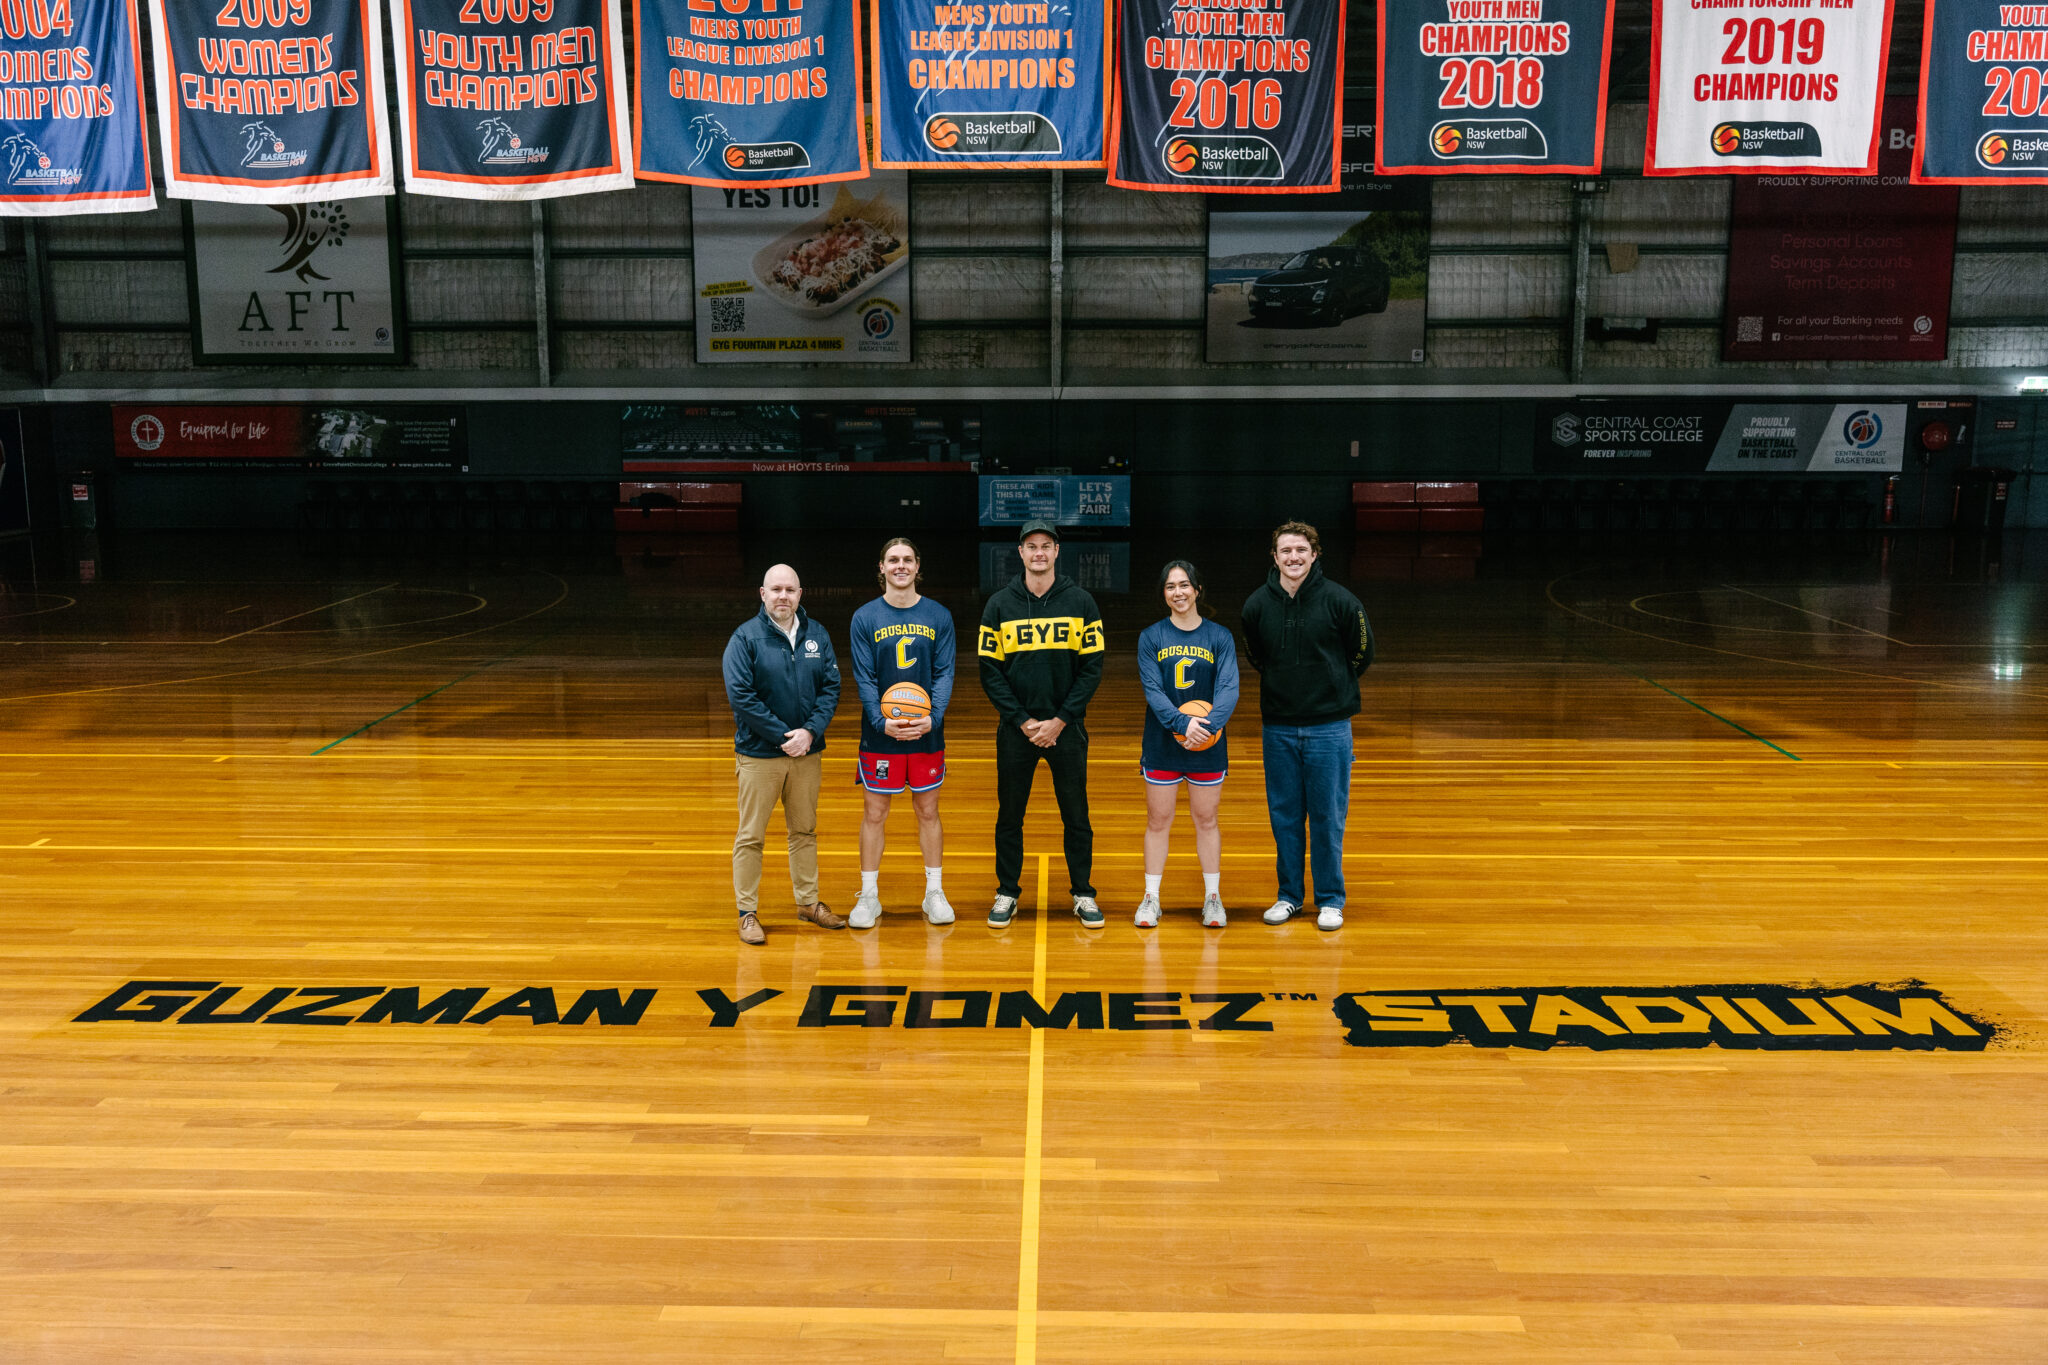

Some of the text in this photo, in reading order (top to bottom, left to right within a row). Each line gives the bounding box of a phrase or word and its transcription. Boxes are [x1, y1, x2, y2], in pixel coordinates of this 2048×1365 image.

[216, 0, 312, 28] 2009
[935, 4, 1048, 25] MENS YOUTH
[1448, 0, 1542, 20] YOUTH MEN
[2000, 5, 2048, 27] YOUT
[0, 0, 73, 39] 004
[690, 16, 802, 40] MENS YOUTH
[1172, 11, 1285, 36] YOUTH MEN
[910, 29, 1073, 51] LEAGUE DIVISION 1
[1420, 22, 1570, 56] CHAMPIONS
[1721, 17, 1825, 65] 2019
[1967, 30, 2048, 62] CHAM
[199, 32, 334, 75] WOMENS
[419, 26, 596, 72] YOUTH MEN
[667, 35, 824, 65] LEAGUE DIVISION 1
[1144, 36, 1311, 72] CHAMPIONS
[908, 58, 1075, 89] CHAMPIONS
[425, 65, 597, 111] CHAMPIONS
[669, 67, 828, 105] CHAMPIONS
[1439, 57, 1543, 109] 2018
[1694, 73, 1839, 102] CHAMPIONS
[0, 83, 114, 120] MPIONS
[180, 70, 359, 115] CHAMPIONS
[1169, 77, 1282, 130] 2016
[965, 121, 1036, 135] Basketball
[1466, 127, 1527, 140] Basketball
[1743, 127, 1804, 141] Basketball
[966, 136, 988, 145] NSW
[1467, 141, 1485, 149] NSW
[1742, 141, 1764, 150] NSW
[261, 150, 307, 161] BASKETBALL
[497, 147, 549, 157] BASKETBALL
[748, 147, 793, 159] Basketball
[1202, 146, 1269, 161] Basketball
[26, 168, 82, 177] BASKETBALL
[1202, 161, 1224, 170] NSW
[1367, 183, 1392, 191] Style
[1758, 177, 1879, 186] PROUDLY SUPPORTING
[722, 184, 819, 208] YES TO!
[1782, 234, 1903, 248] Personal Loans
[1770, 255, 1912, 273] Savings Accounts
[1785, 275, 1895, 291] Term Deposits
[1778, 315, 1903, 327] For all your Banking needs
[712, 339, 842, 350] GYG FOUNTAIN PLAZA 4 MINS
[180, 421, 270, 441] Equipped for Life
[1584, 416, 1703, 429] CENTRAL COAST
[1751, 417, 1790, 427] PROUDLY
[1584, 430, 1704, 442] SPORTS COLLEGE
[1742, 427, 1796, 438] SUPPORTING
[1741, 438, 1796, 448] BASKETBALL
[1584, 449, 1653, 458] FOREVER INSPIRING
[1737, 449, 1798, 458] ON THE COAST
[753, 463, 850, 472] Now at HOYTS Erina
[1079, 482, 1113, 492] LET'S
[1079, 493, 1112, 503] PLAY
[1079, 504, 1111, 514] FAIR!
[874, 624, 936, 643] CRUSADERS
[1016, 622, 1069, 645] GYG
[896, 636, 918, 669] C
[1157, 645, 1214, 664] CRUSADERS
[1174, 657, 1197, 690] C
[892, 690, 925, 704] Wilson
[69, 980, 660, 1027] GUZMAN
[695, 987, 785, 1028] Y
[1352, 995, 1982, 1036] STADIUM
